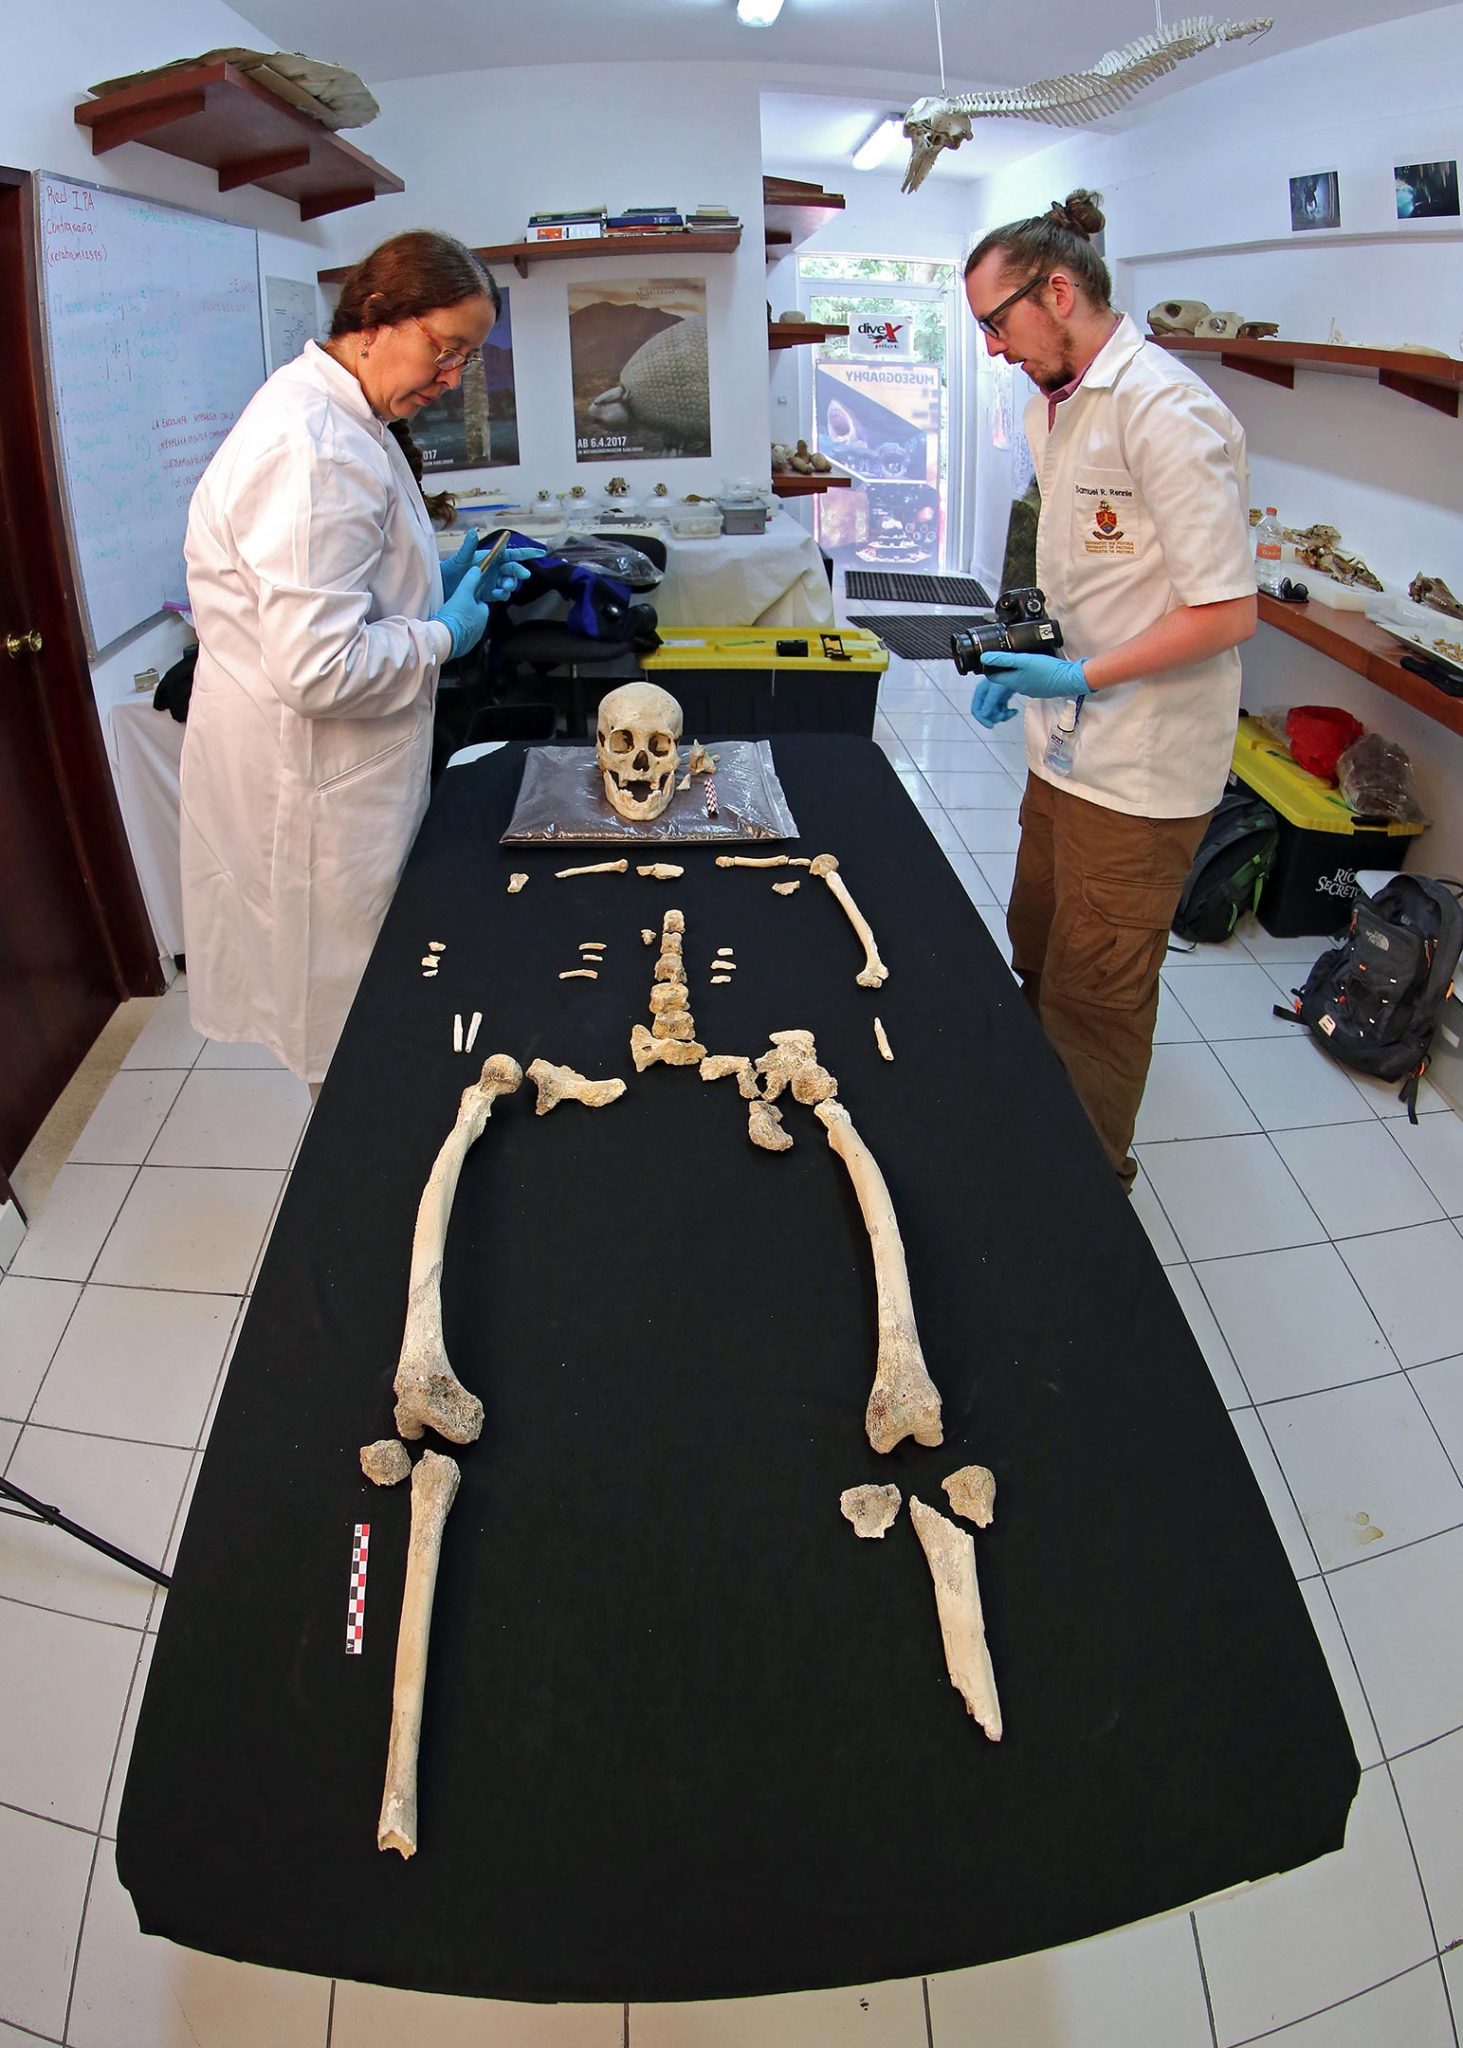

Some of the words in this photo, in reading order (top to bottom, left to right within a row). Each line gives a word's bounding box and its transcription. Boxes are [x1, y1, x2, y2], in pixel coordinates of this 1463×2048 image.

[577, 438, 589, 448] AB
[590, 436, 627, 448] 6.4.2017
[1075, 485, 1098, 496] Samuel
[1109, 488, 1133, 497] Rennie
